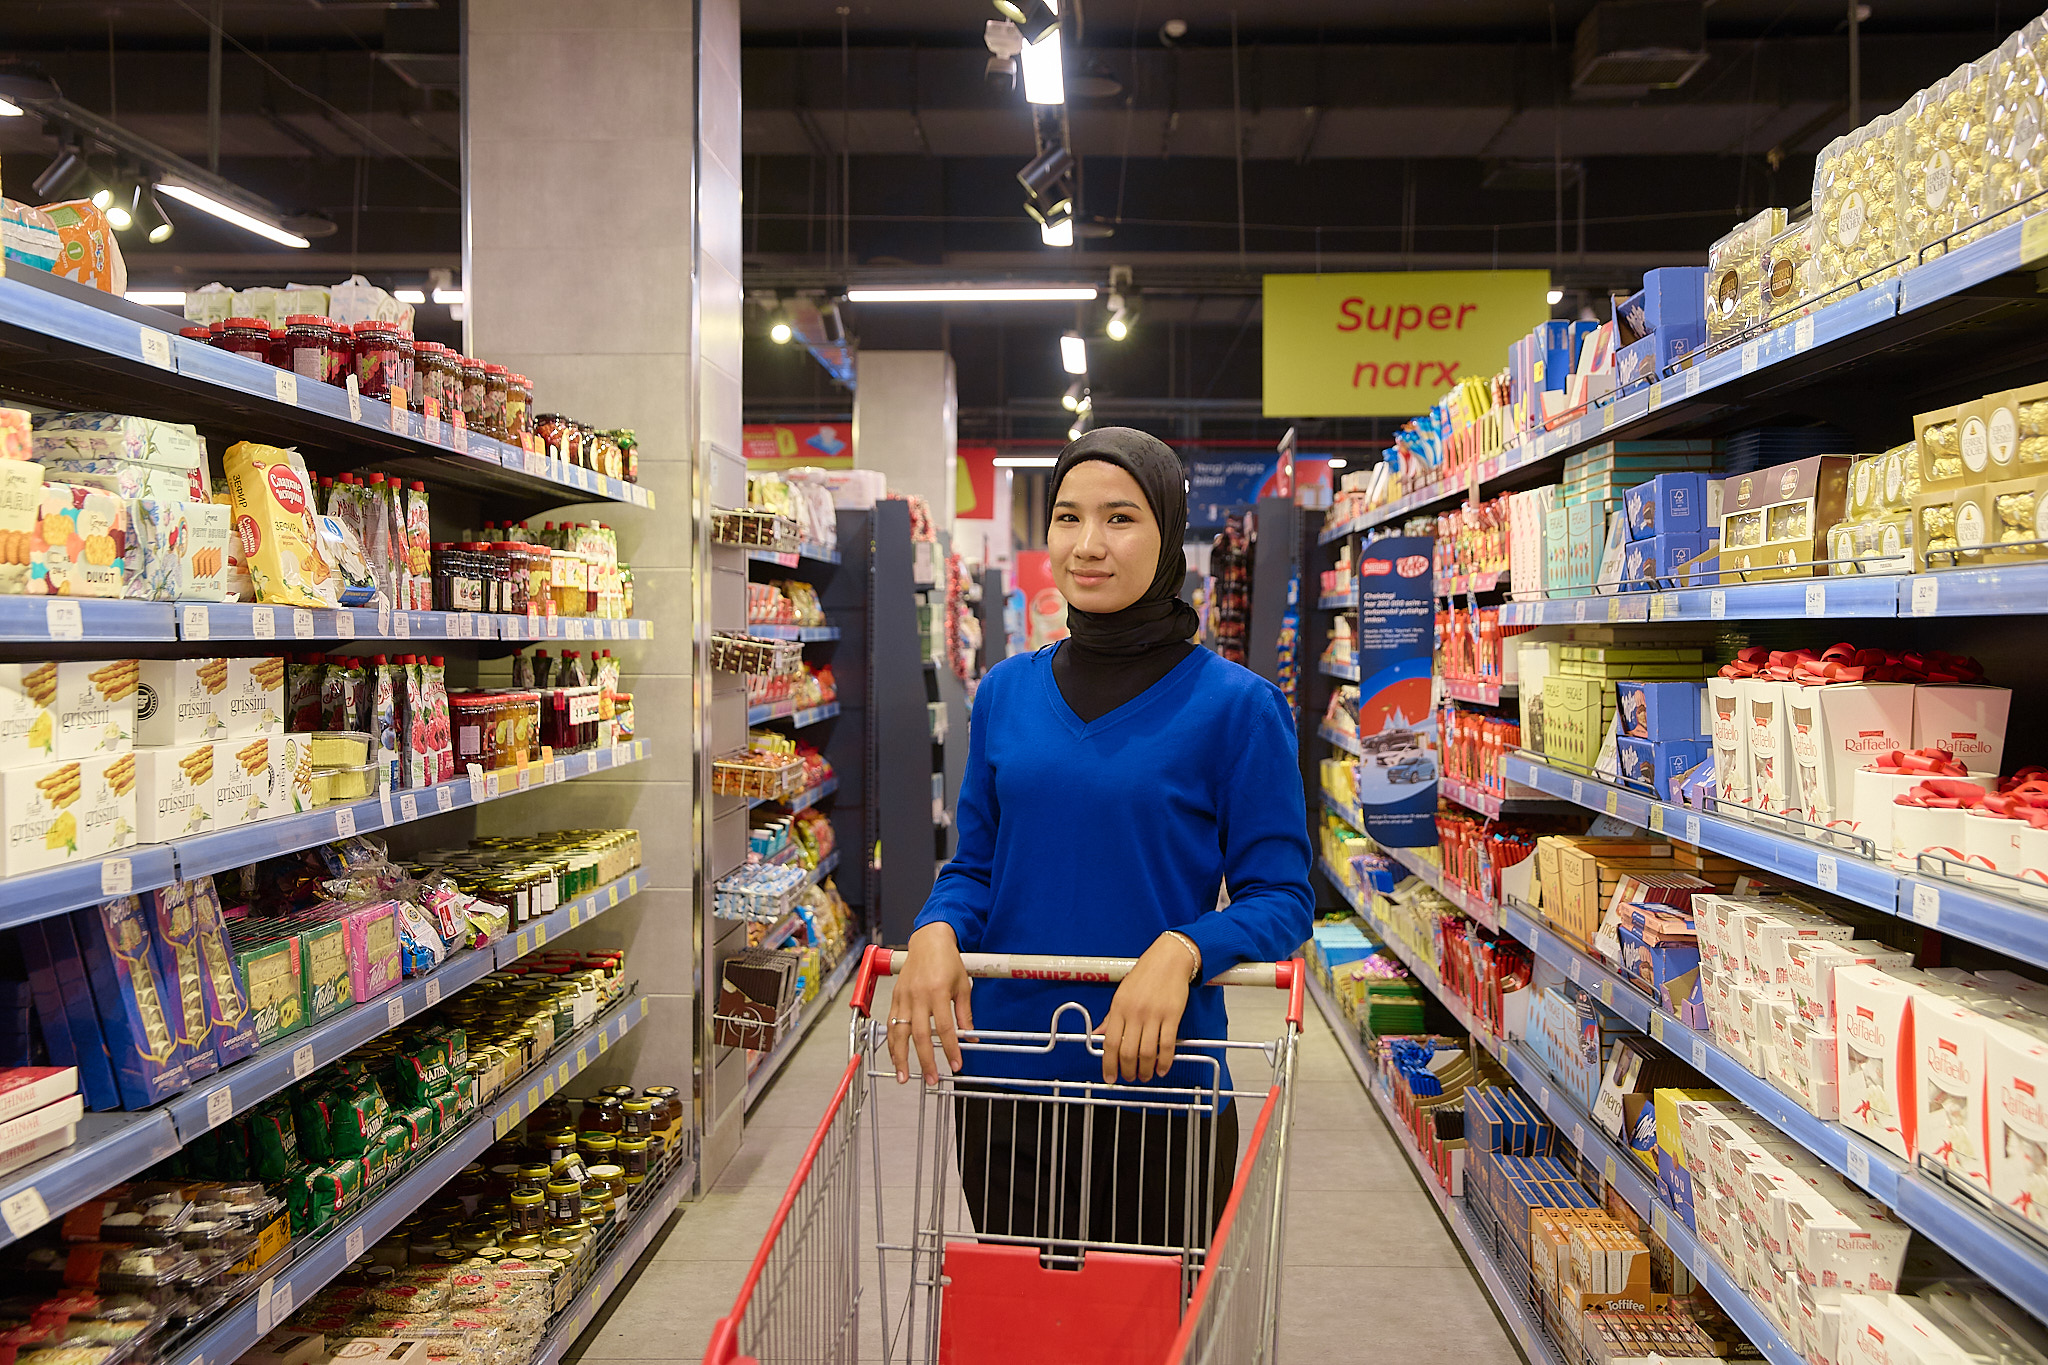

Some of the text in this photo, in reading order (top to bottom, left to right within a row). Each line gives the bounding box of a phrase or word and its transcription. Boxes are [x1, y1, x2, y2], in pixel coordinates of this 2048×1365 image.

[1337, 296, 1477, 340] Super
[1353, 360, 1461, 389] narx
[86, 571, 115, 584] DUKAT
[62, 704, 109, 733] grissini
[178, 697, 211, 722] grissini
[231, 694, 266, 717] grissini
[1715, 721, 1739, 742] Raffaello
[1751, 727, 1776, 749] Raffaello
[1845, 738, 1900, 753] Raffaello
[1936, 739, 1992, 754] Raffaello
[158, 788, 195, 818] grissini
[217, 779, 252, 807] grissini
[10, 812, 58, 847] grissini
[85, 801, 119, 832] grissini
[314, 974, 336, 1014] Tolib
[252, 998, 279, 1035] Tolib
[1846, 1013, 1886, 1048] Raffaello
[423, 1064, 450, 1083] ХАЛВА
[1928, 1045, 1970, 1085] Raffaello
[1669, 1169, 1685, 1194] YOU
[1836, 1238, 1885, 1250] Raffaello
[1605, 1299, 1646, 1312] Toffifee
